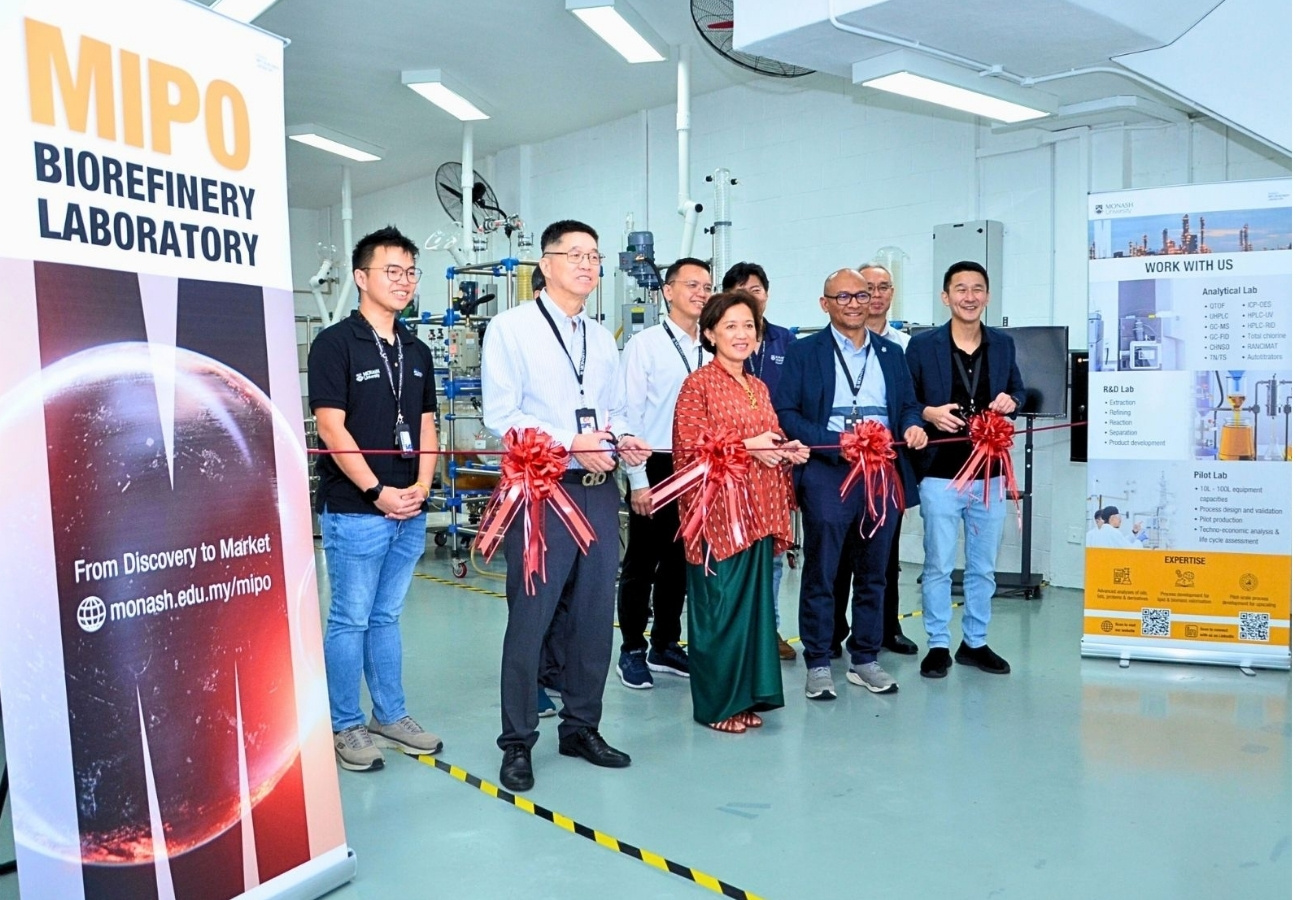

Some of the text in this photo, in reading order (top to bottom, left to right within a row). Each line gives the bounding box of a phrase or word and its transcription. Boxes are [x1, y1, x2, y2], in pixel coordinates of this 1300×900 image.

[24, 16, 251, 172] MIPO
[34, 140, 256, 220] BIOREFINERY
[38, 197, 259, 266] LABORATORY
[1145, 258, 1234, 273] WORK WITH US
[1202, 286, 1258, 296] Analytical Lab
[1110, 409, 1132, 417] Refining
[1110, 429, 1138, 437] Separation
[1130, 439, 1166, 448] development
[1194, 471, 1212, 479] Pilot
[1232, 486, 1263, 494] equipment
[1222, 506, 1242, 514] design
[1213, 516, 1243, 524] production
[74, 534, 272, 583] From Discovery to Market
[1164, 556, 1206, 565] EXPERTISE
[110, 573, 272, 621] monash.edu.my/mipo
